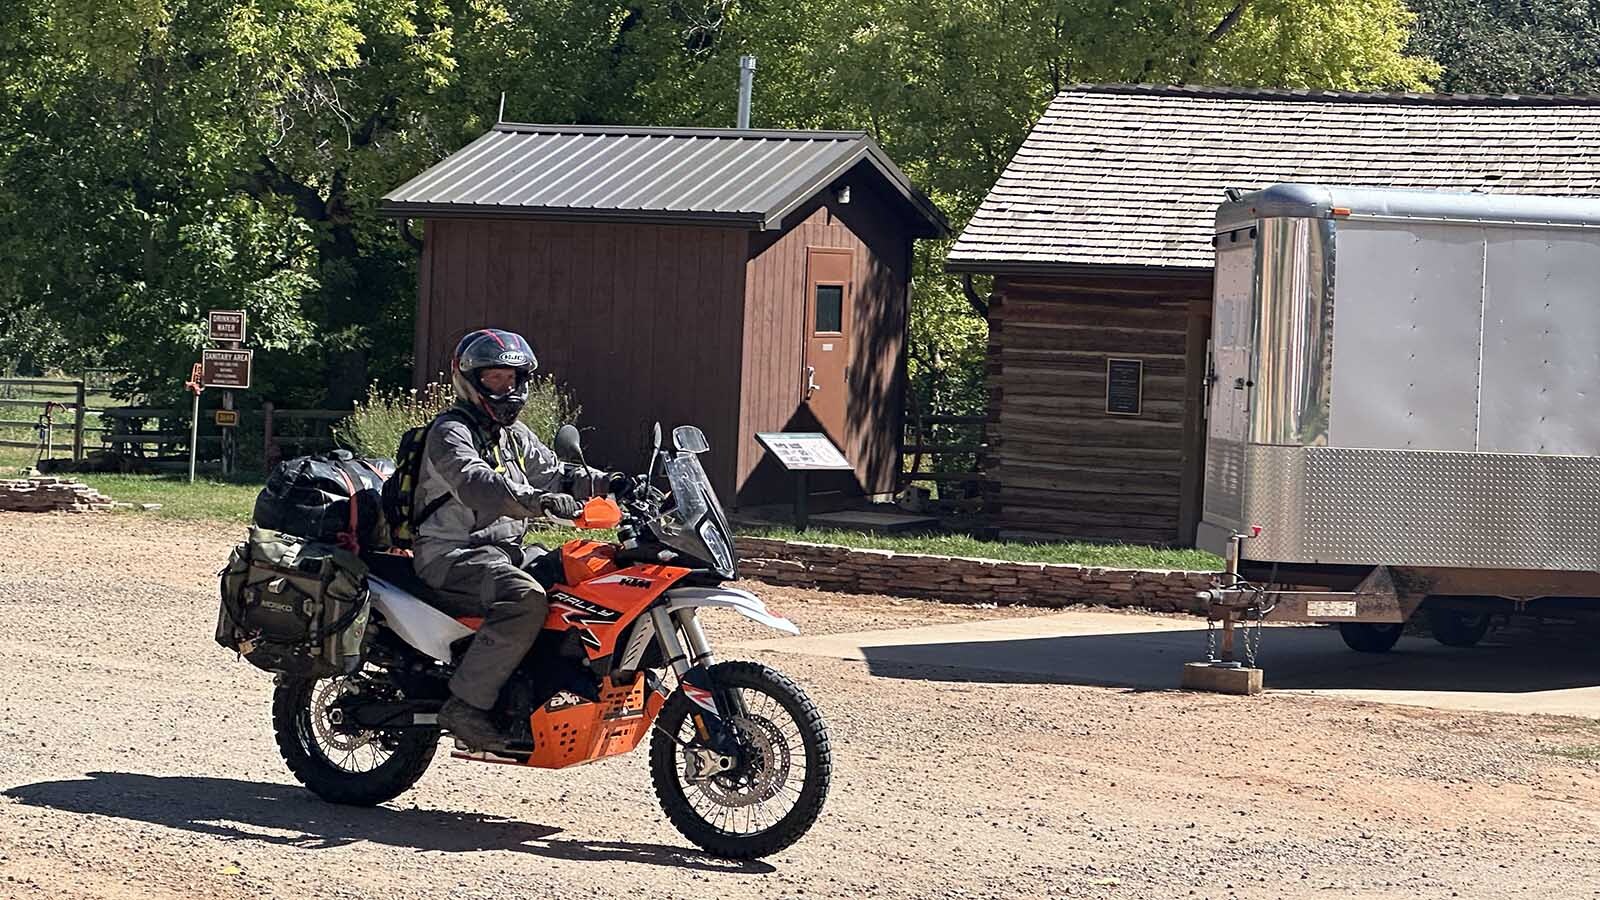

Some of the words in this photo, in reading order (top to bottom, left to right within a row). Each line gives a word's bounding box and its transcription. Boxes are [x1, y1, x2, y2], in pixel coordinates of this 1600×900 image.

[217, 324, 236, 332] WATER
[205, 352, 232, 360] SANITARY
[232, 353, 248, 361] AREA
[619, 577, 651, 589] KTM
[552, 592, 616, 617] RALLY
